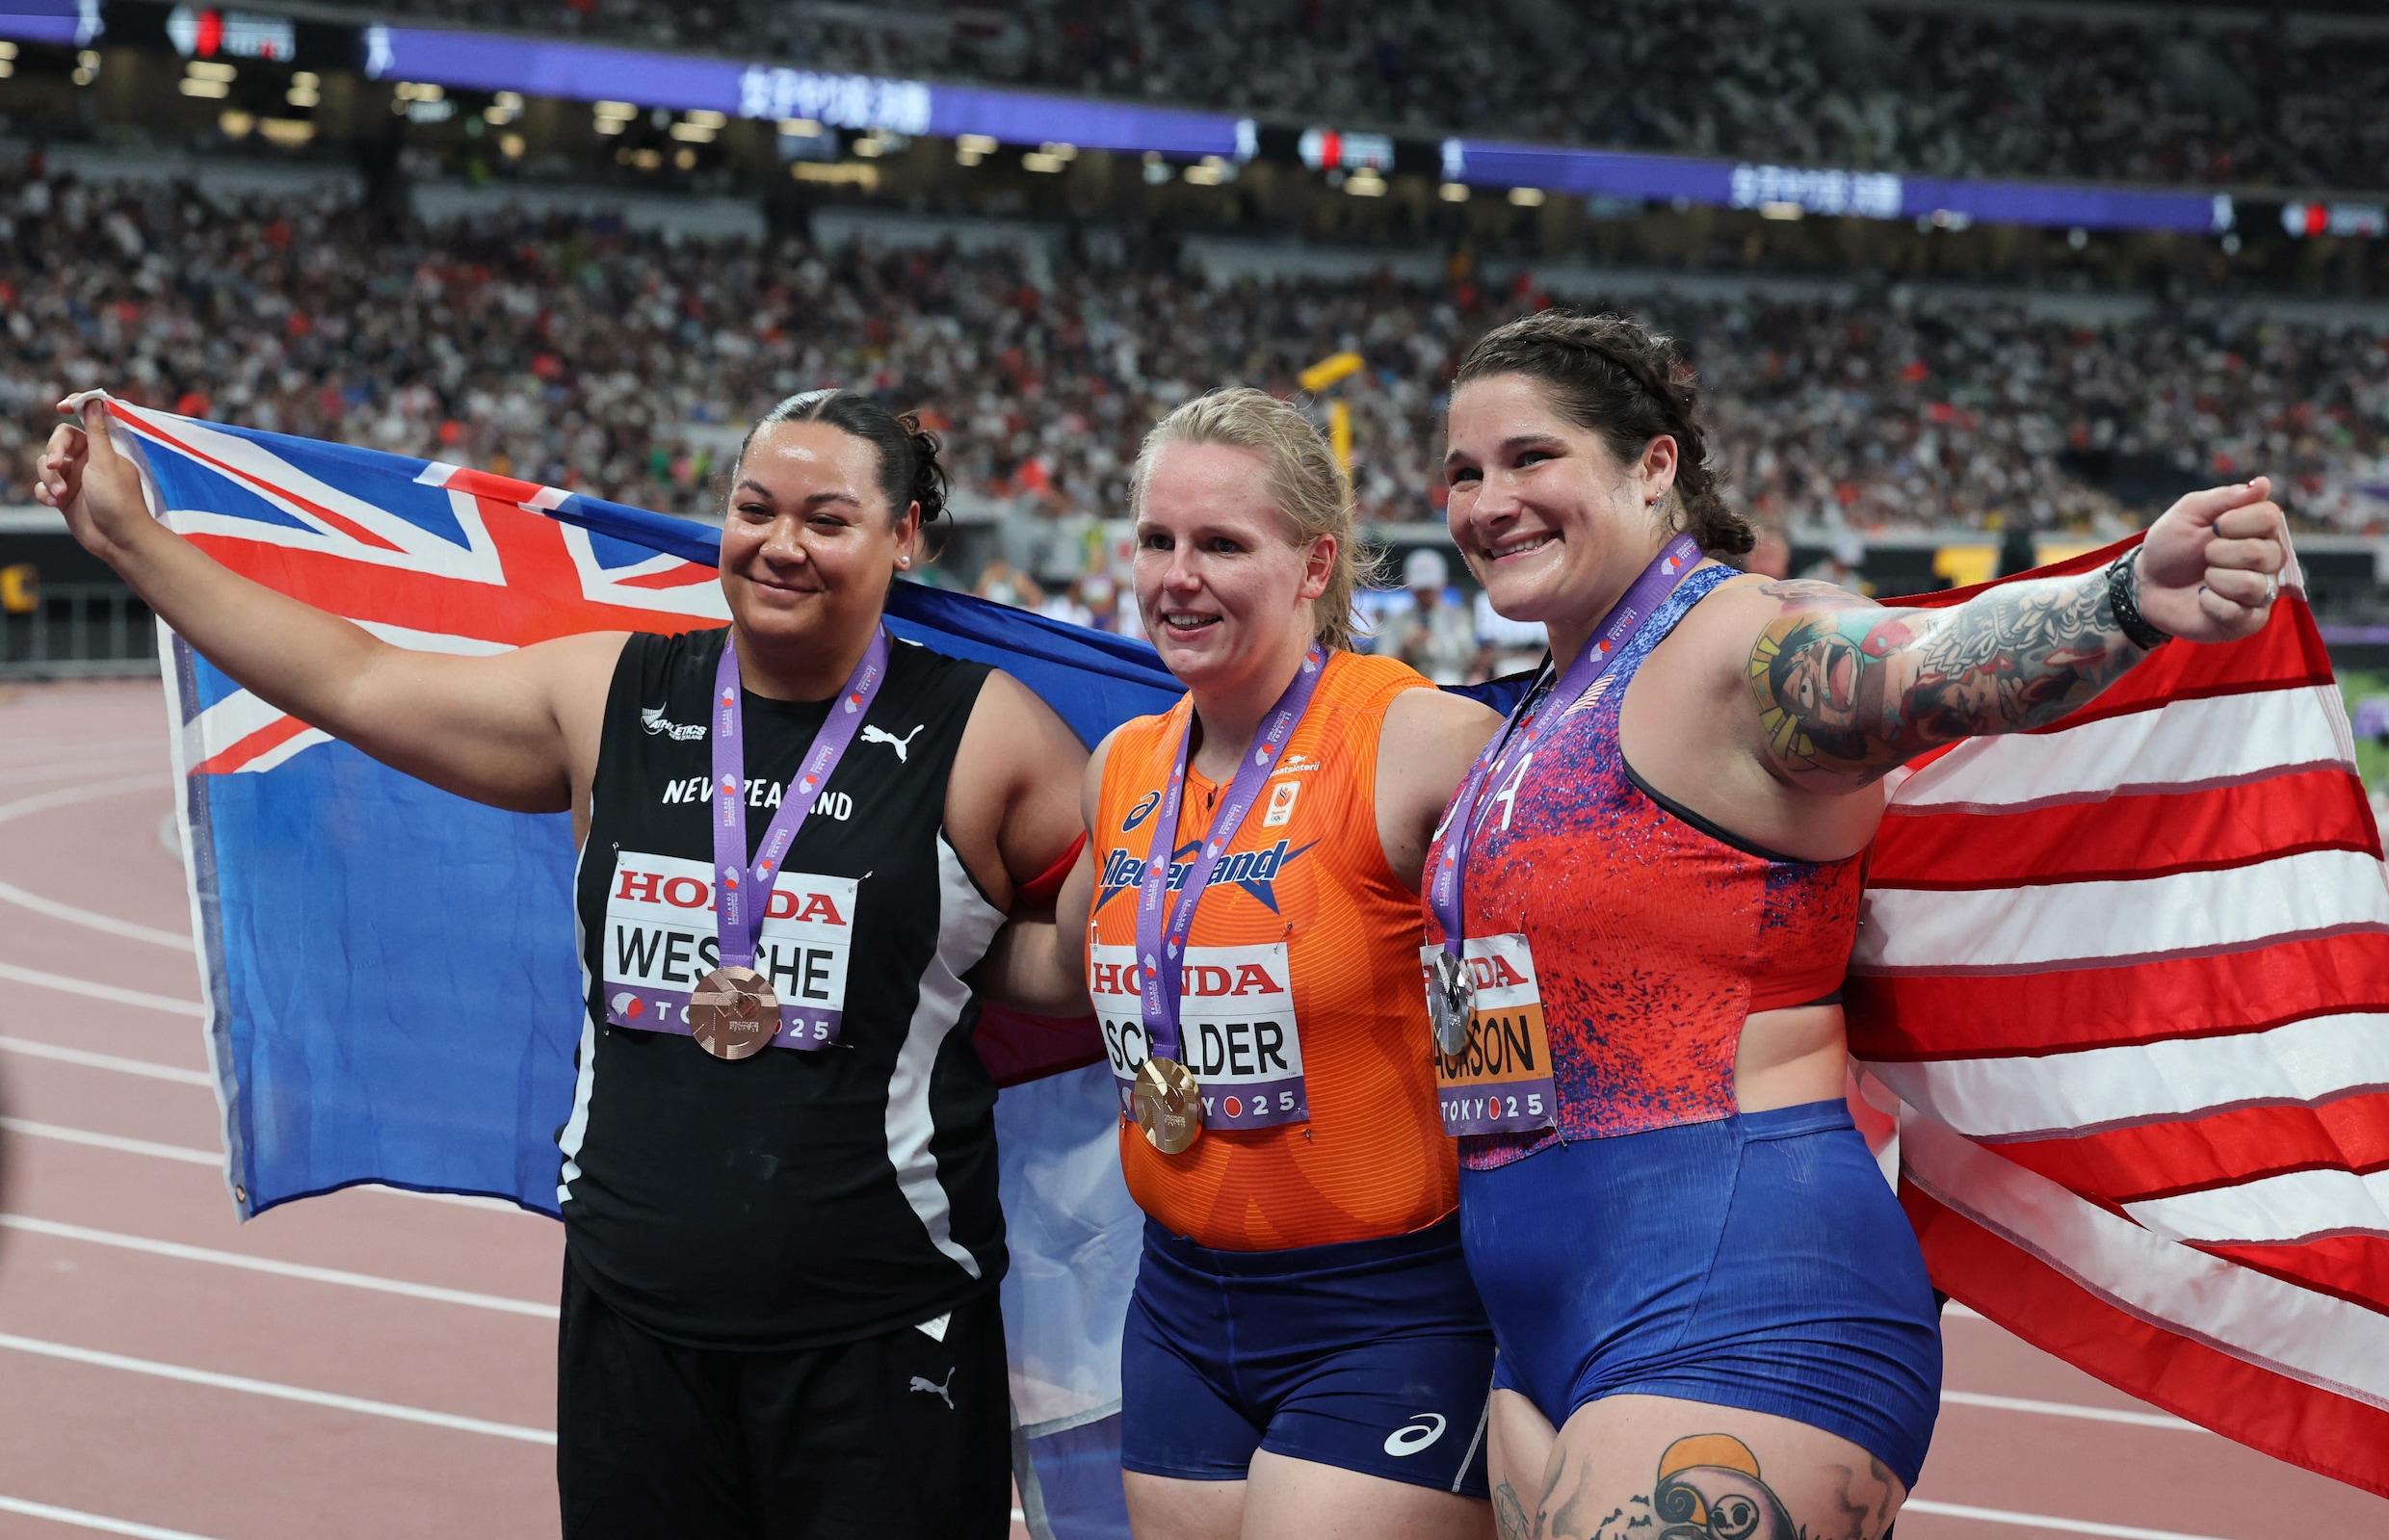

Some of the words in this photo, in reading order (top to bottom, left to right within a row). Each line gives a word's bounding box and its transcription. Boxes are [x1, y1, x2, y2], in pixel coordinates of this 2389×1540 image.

[648, 719, 707, 736] ATHLETICS
[744, 778, 853, 821] EAND
[1100, 839, 1290, 891] Neerand
[616, 871, 846, 926] HODA
[617, 925, 833, 1000] WESHE
[1106, 1019, 1288, 1076] SCLDER
